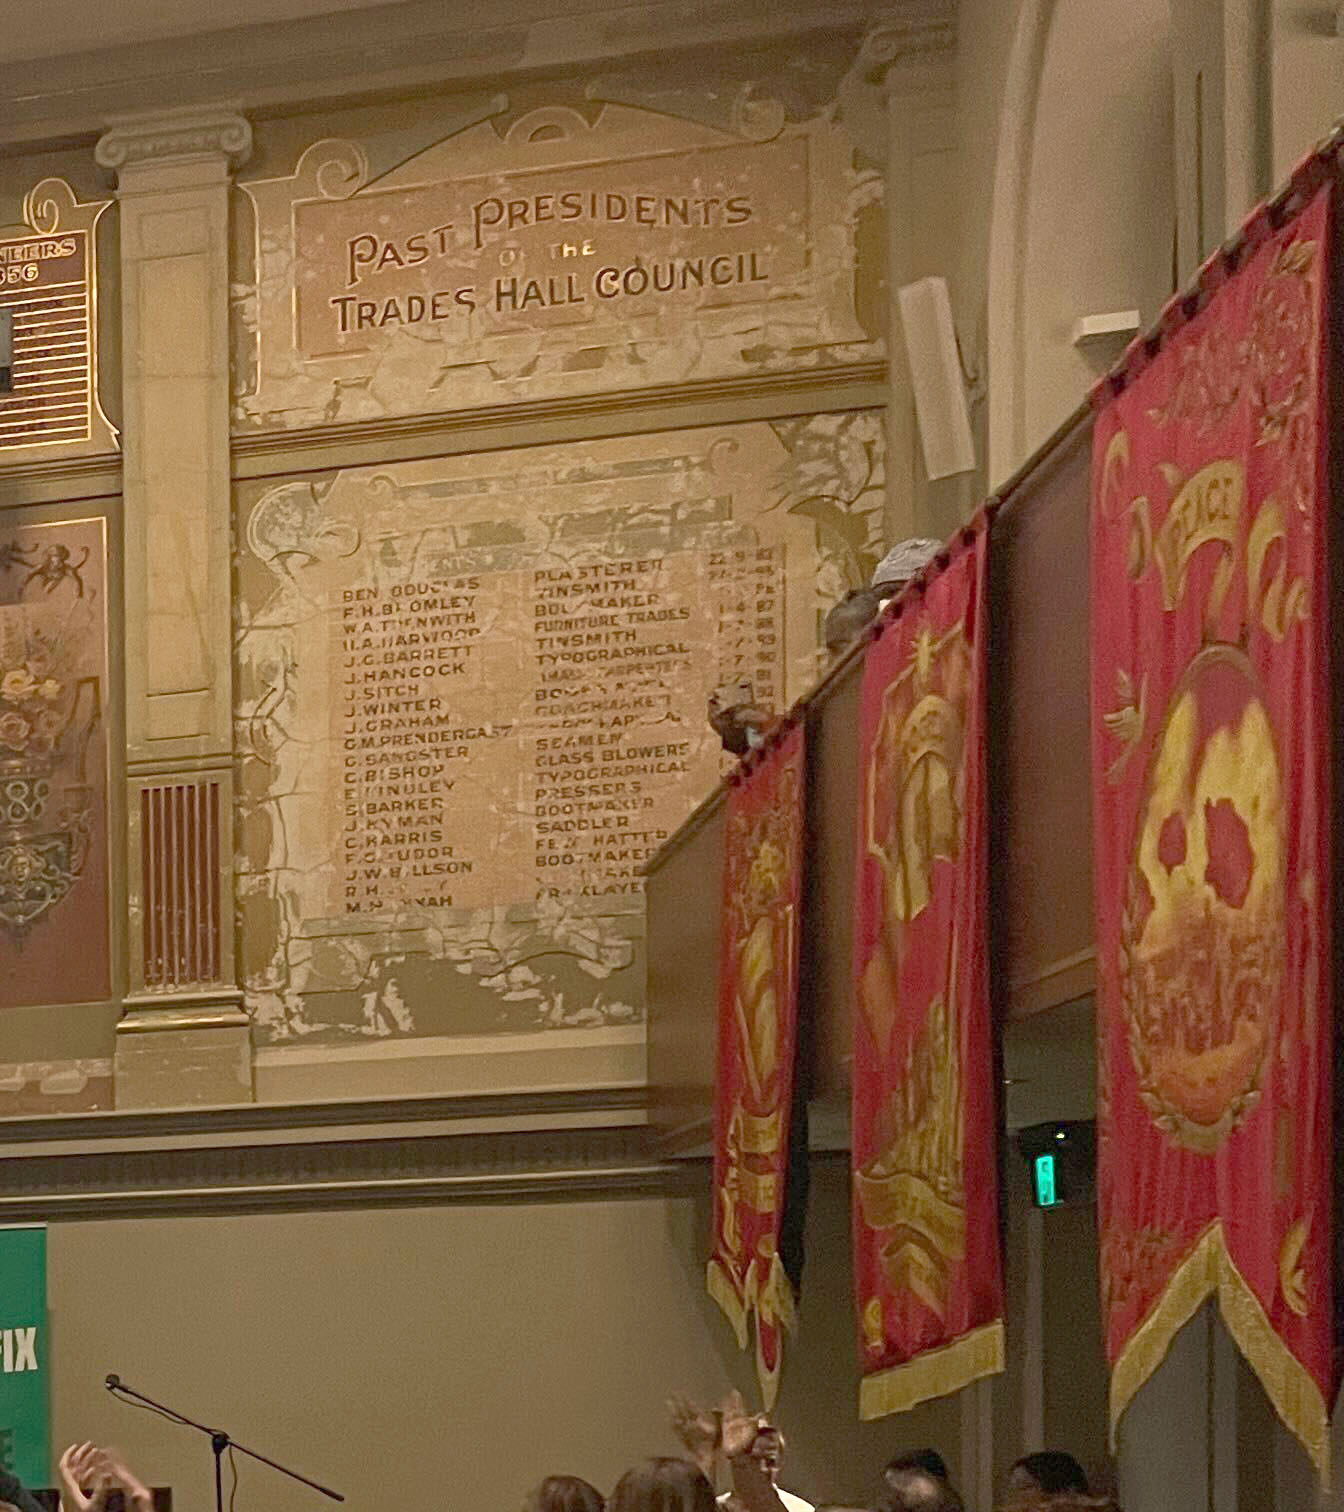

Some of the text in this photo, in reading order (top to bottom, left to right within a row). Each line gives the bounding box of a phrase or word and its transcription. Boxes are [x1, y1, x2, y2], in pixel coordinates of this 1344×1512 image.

[348, 192, 753, 286] PAST PRESIDENTS
[546, 239, 597, 260] THE
[332, 252, 770, 334] TRADES HALL COUNCIL
[343, 586, 379, 603] BEN
[626, 606, 691, 624] TRADES
[535, 629, 637, 649] TINSMITH
[344, 662, 466, 685] J.HANCOCK
[344, 698, 442, 718] J.WINTER
[536, 741, 690, 768] GLASS BLOWERS
[536, 815, 629, 834] SADDLER
